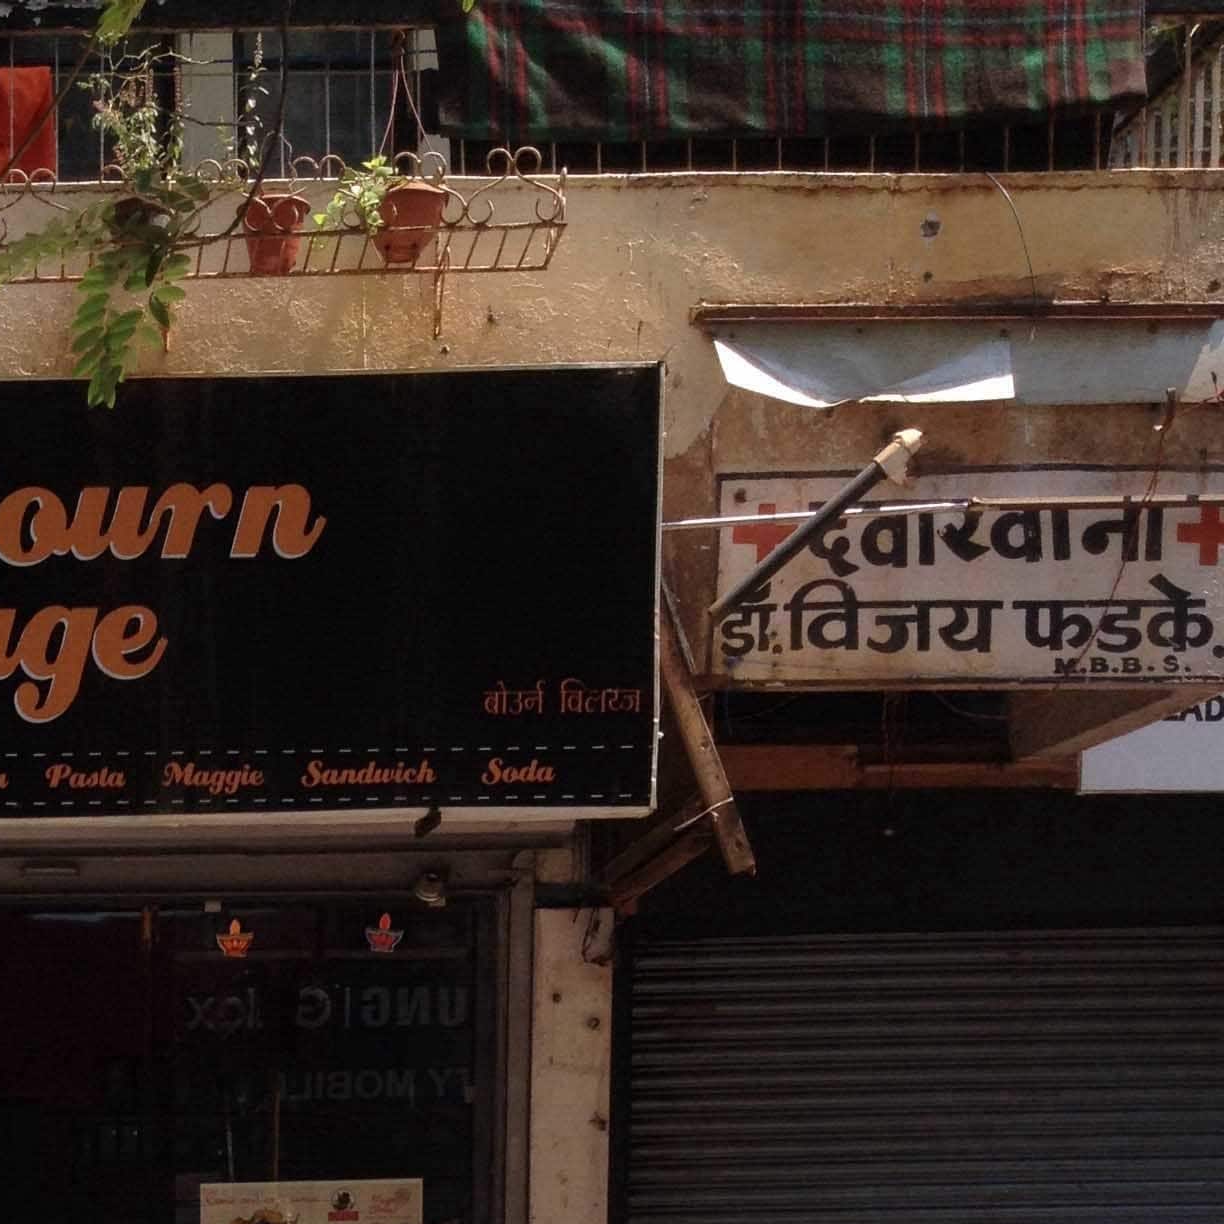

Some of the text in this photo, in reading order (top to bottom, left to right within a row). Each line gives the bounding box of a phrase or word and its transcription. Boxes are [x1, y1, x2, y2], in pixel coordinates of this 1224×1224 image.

[784, 579, 1004, 653] विजय
[1054, 655, 1192, 675] M.B.B.S.
[44, 763, 127, 789] Pasta
[162, 762, 264, 794] Maggie
[301, 760, 437, 787] Sandwich
[481, 758, 556, 784] Soda
